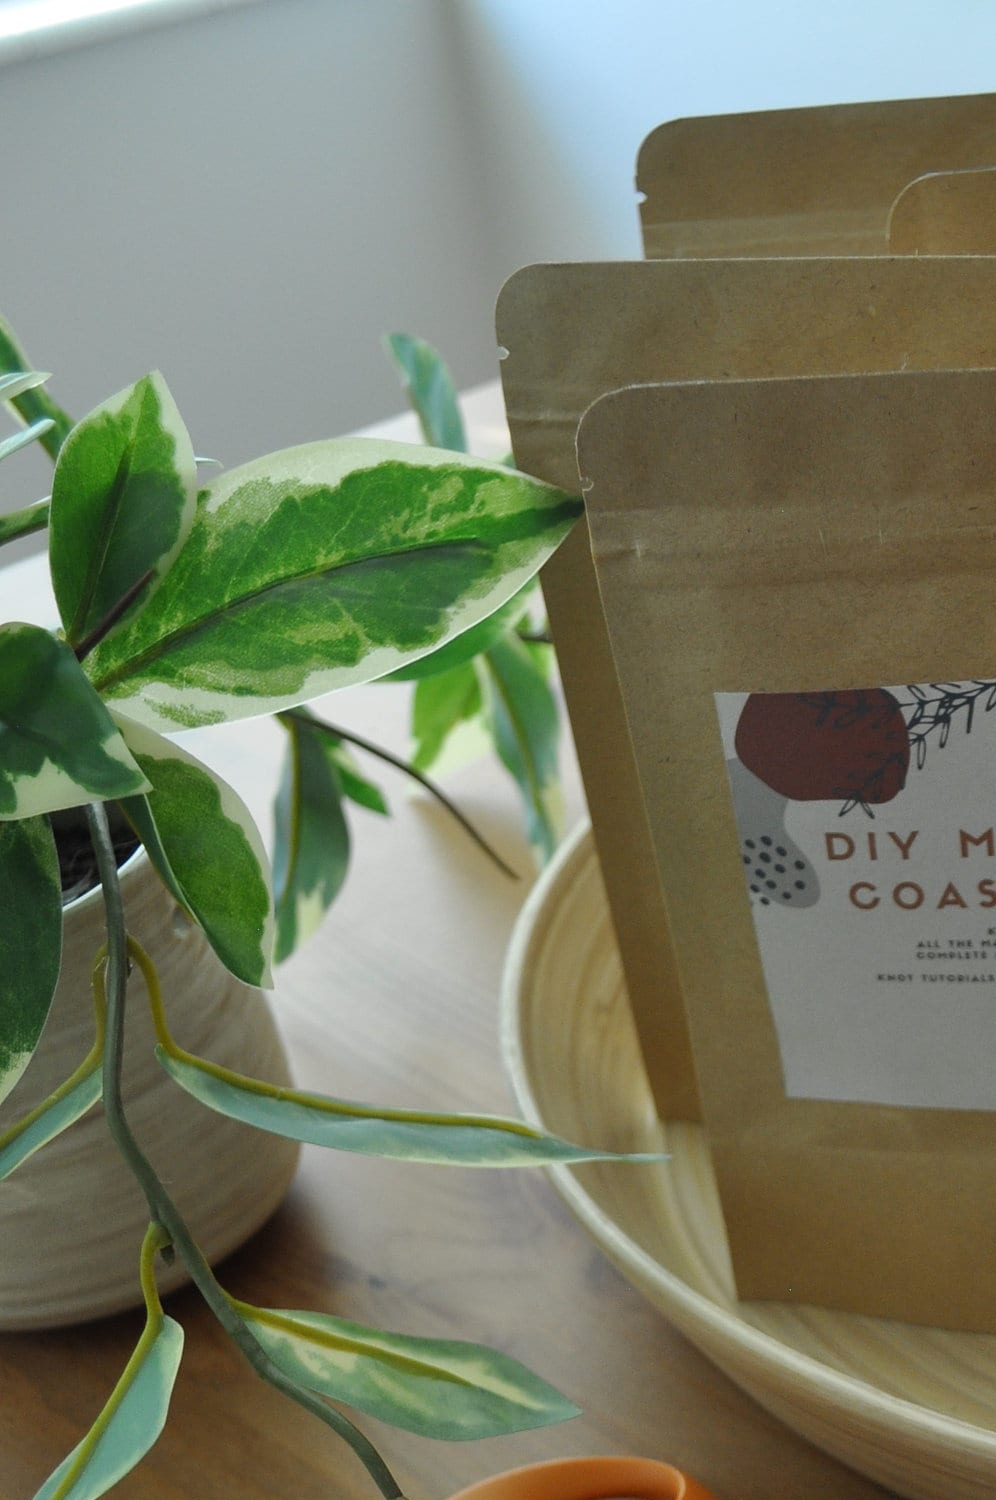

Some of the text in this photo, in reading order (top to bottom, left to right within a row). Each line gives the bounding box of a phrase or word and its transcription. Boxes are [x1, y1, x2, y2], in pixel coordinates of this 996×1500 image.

[824, 830, 919, 860] DIY
[917, 939, 940, 948] ALL
[949, 939, 973, 948] THE
[916, 950, 987, 960] COMPLETE
[877, 973, 913, 982] KNOT
